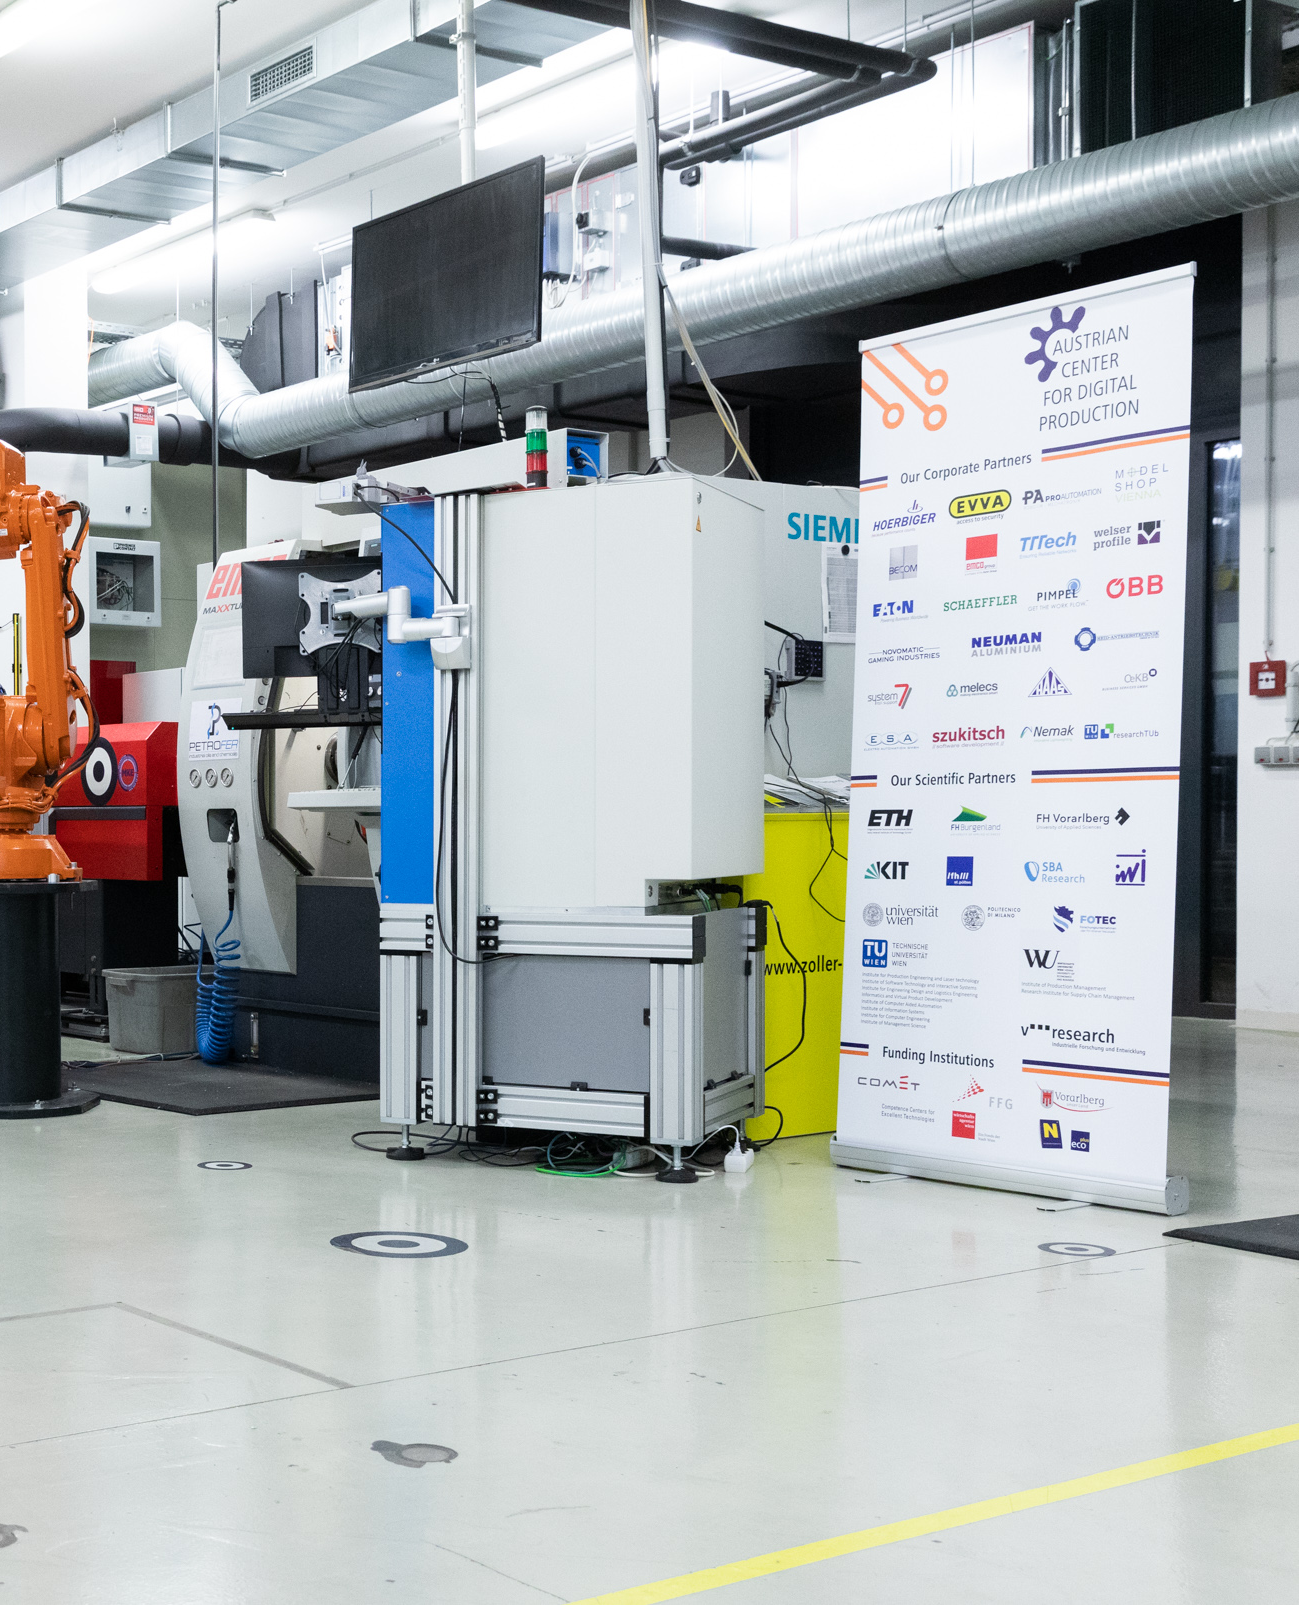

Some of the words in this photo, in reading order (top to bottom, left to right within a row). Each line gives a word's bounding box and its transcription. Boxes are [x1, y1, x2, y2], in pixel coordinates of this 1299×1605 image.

[1052, 324, 1129, 356] AUSTRIAN
[1061, 352, 1119, 378] CENTER
[1043, 387, 1072, 406] FOR
[1078, 374, 1137, 400] DIGITAL
[1039, 399, 1139, 431] PRODUCTION
[900, 472, 920, 484] Our
[923, 462, 980, 481] Corporate
[983, 453, 1032, 471] Partners
[1114, 477, 1157, 492] SHOP
[956, 495, 1004, 514] EVVA
[872, 512, 937, 532] HOERBIGER
[981, 513, 1004, 522] security
[1093, 525, 1132, 538] welser
[1020, 531, 1077, 552] TTTech
[1093, 535, 1131, 551] profile
[889, 564, 918, 575] BECOM
[966, 561, 984, 571] emco
[1106, 574, 1164, 599] ÖBB
[1036, 588, 1078, 602] PIMPEL
[943, 594, 1018, 612] SCHAEFFLER
[971, 631, 1042, 648] NEUMAN
[882, 646, 924, 655] NOVOMATIC
[971, 644, 1042, 658] ALUMINIUM
[867, 655, 895, 664] GAMING
[896, 652, 941, 662] INDUSTRIES
[960, 681, 998, 693] melecs
[867, 692, 899, 705] system
[932, 725, 1005, 743] szukitsch
[1033, 725, 1075, 738] Nemak
[1085, 725, 1098, 734] TU
[1113, 730, 1160, 738] researchTUb
[188, 739, 239, 752] PETROFER
[890, 774, 912, 786] Our
[915, 773, 965, 786] Scientific
[968, 773, 1016, 785] Partners
[867, 809, 913, 827] ETH
[1036, 813, 1050, 823] FH
[1052, 813, 1110, 826] Vorarlberg
[950, 823, 960, 831] FH
[960, 823, 1001, 832] Burgenland
[876, 861, 910, 880] KIT
[1042, 861, 1063, 872] SBA
[1041, 873, 1085, 883] Research
[885, 904, 939, 917] universität
[885, 915, 914, 926] wien
[1080, 915, 1117, 925] FOTEC
[863, 941, 887, 957] TU
[892, 942, 928, 950] TECHNISCHE
[891, 951, 928, 959] UNIVERSITÄT
[1023, 949, 1060, 969] WU
[1051, 1041, 1078, 1049] Industrielle
[1078, 1044, 1104, 1053] Forschung
[1116, 1047, 1146, 1056] Entwicklung
[882, 1046, 926, 1065] Funding
[929, 1054, 995, 1068] Institutions
[857, 1075, 921, 1091] COMET
[989, 1097, 1013, 1110] FFG
[1054, 1091, 1105, 1108] Vorarlberg
[881, 1103, 909, 1112] Competence
[909, 1106, 928, 1114] Centers
[881, 1110, 903, 1118] Excellent
[903, 1113, 935, 1123] Technologies
[1042, 1122, 1059, 1139] N
[1071, 1141, 1087, 1149] eco
